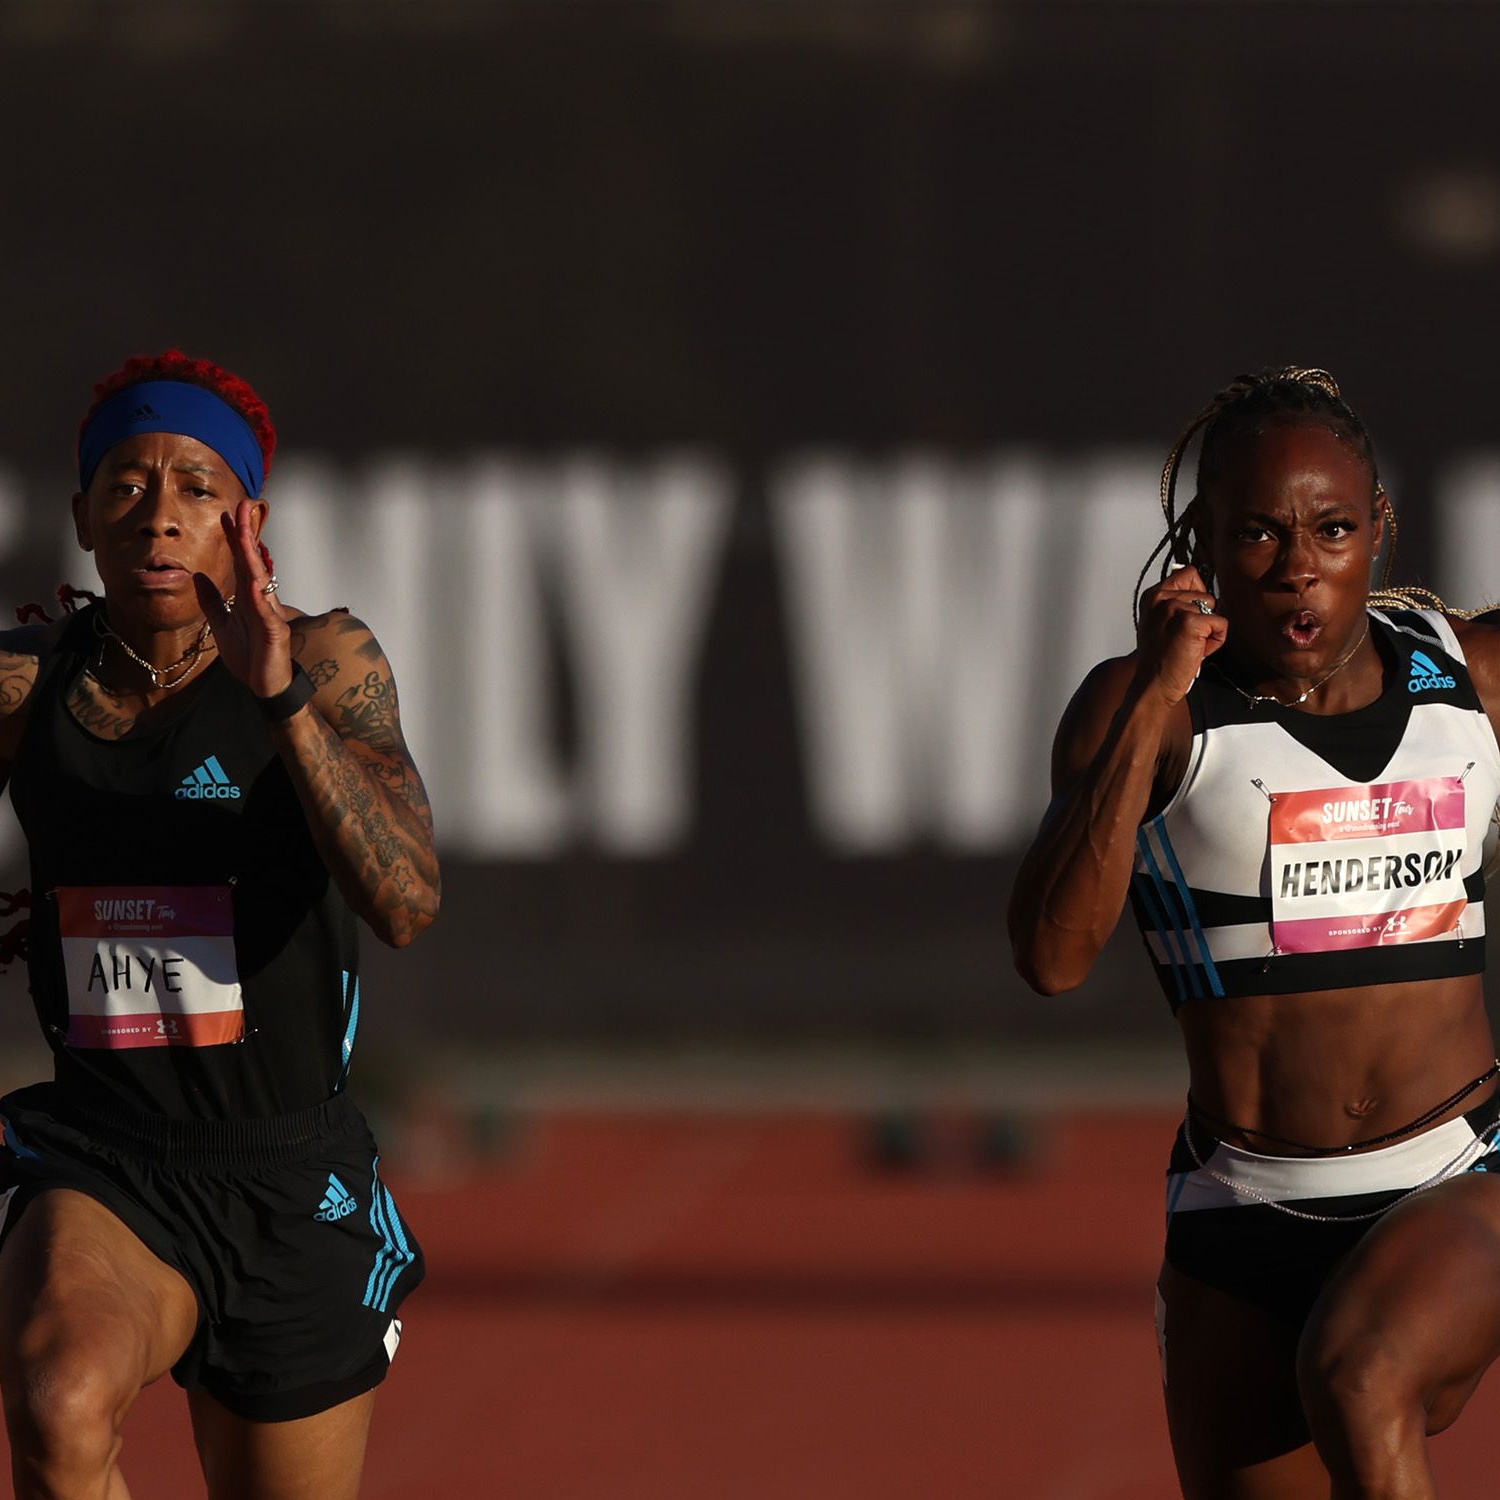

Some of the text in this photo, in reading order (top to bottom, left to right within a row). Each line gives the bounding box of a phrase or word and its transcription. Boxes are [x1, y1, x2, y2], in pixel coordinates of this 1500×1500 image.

[270, 458, 736, 856] NLY
[1407, 673, 1457, 694] addas
[174, 782, 243, 800] adidas
[1322, 797, 1393, 825] SUNSET
[1280, 849, 1463, 899] HENDERSON
[93, 899, 156, 921] SUNSET
[1328, 926, 1371, 937] SPONSORED
[88, 953, 184, 994] AHYE
